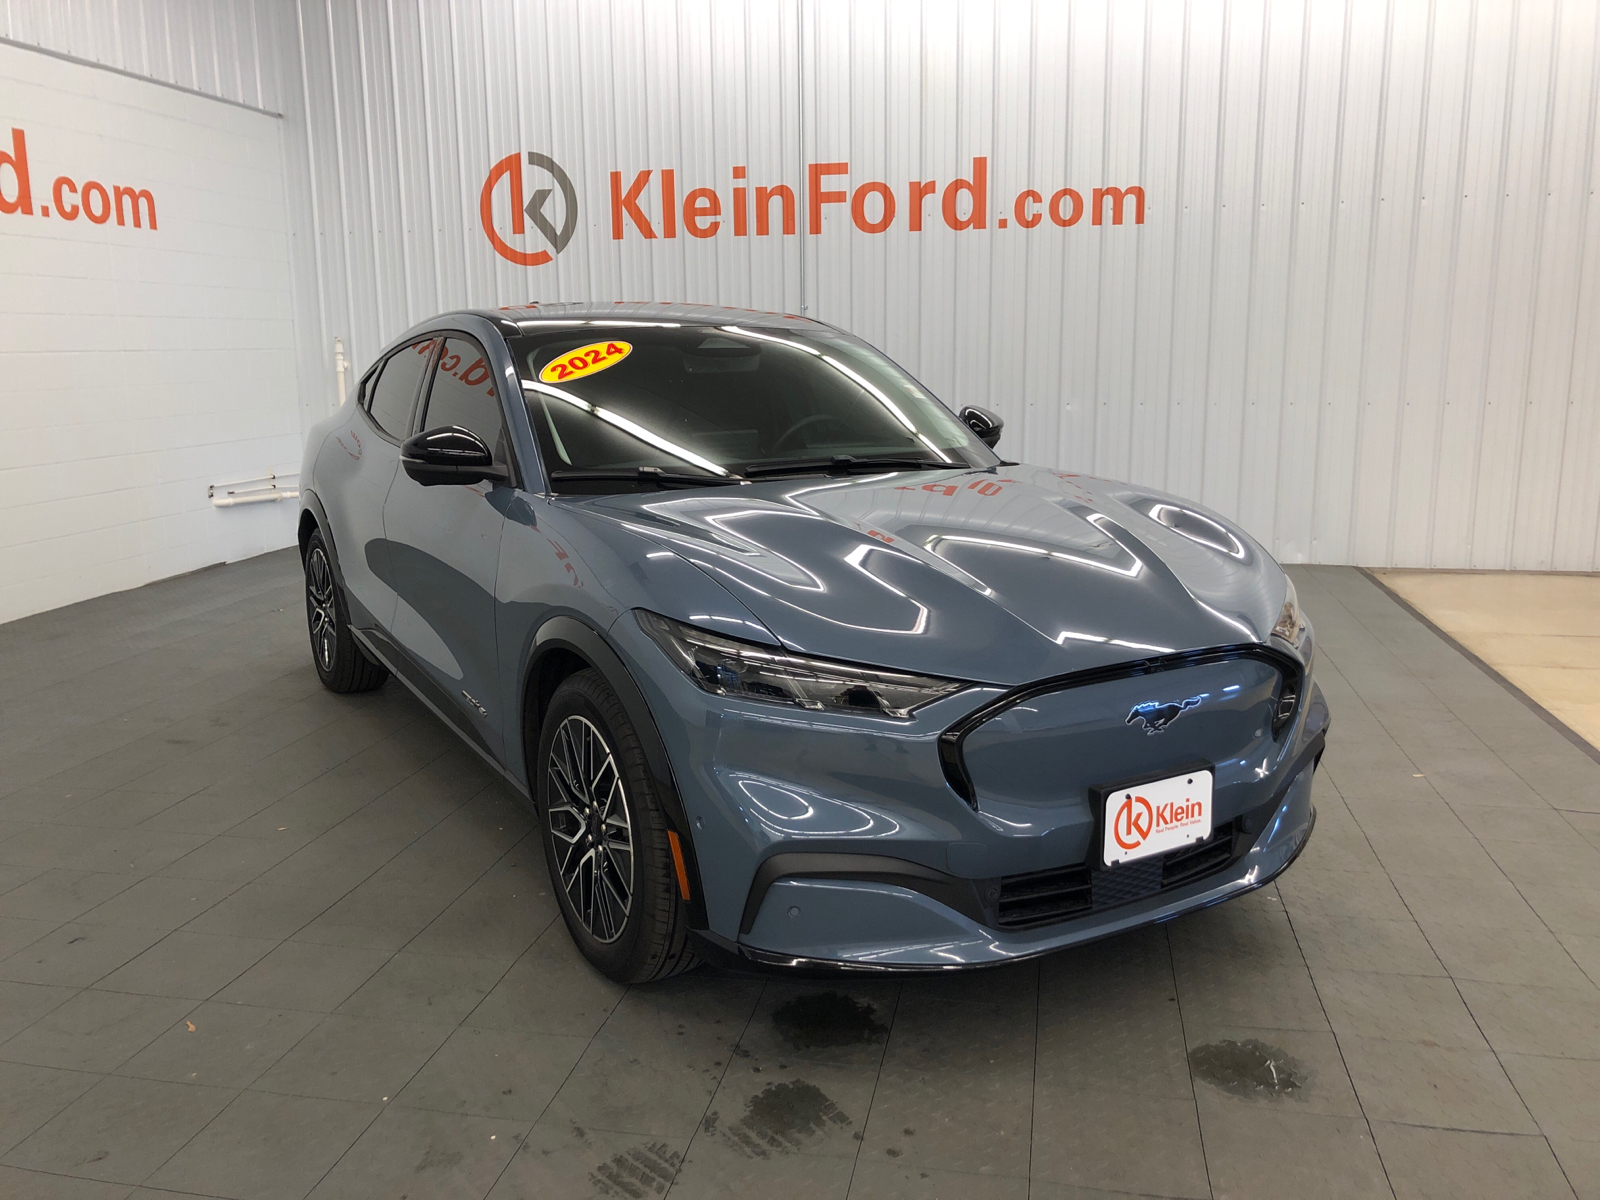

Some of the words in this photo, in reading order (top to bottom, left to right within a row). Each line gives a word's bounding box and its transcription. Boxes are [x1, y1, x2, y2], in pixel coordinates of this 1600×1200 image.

[609, 156, 1146, 240] KleinFord.com
[550, 342, 624, 380] 2024
[1155, 797, 1203, 828] Klein
